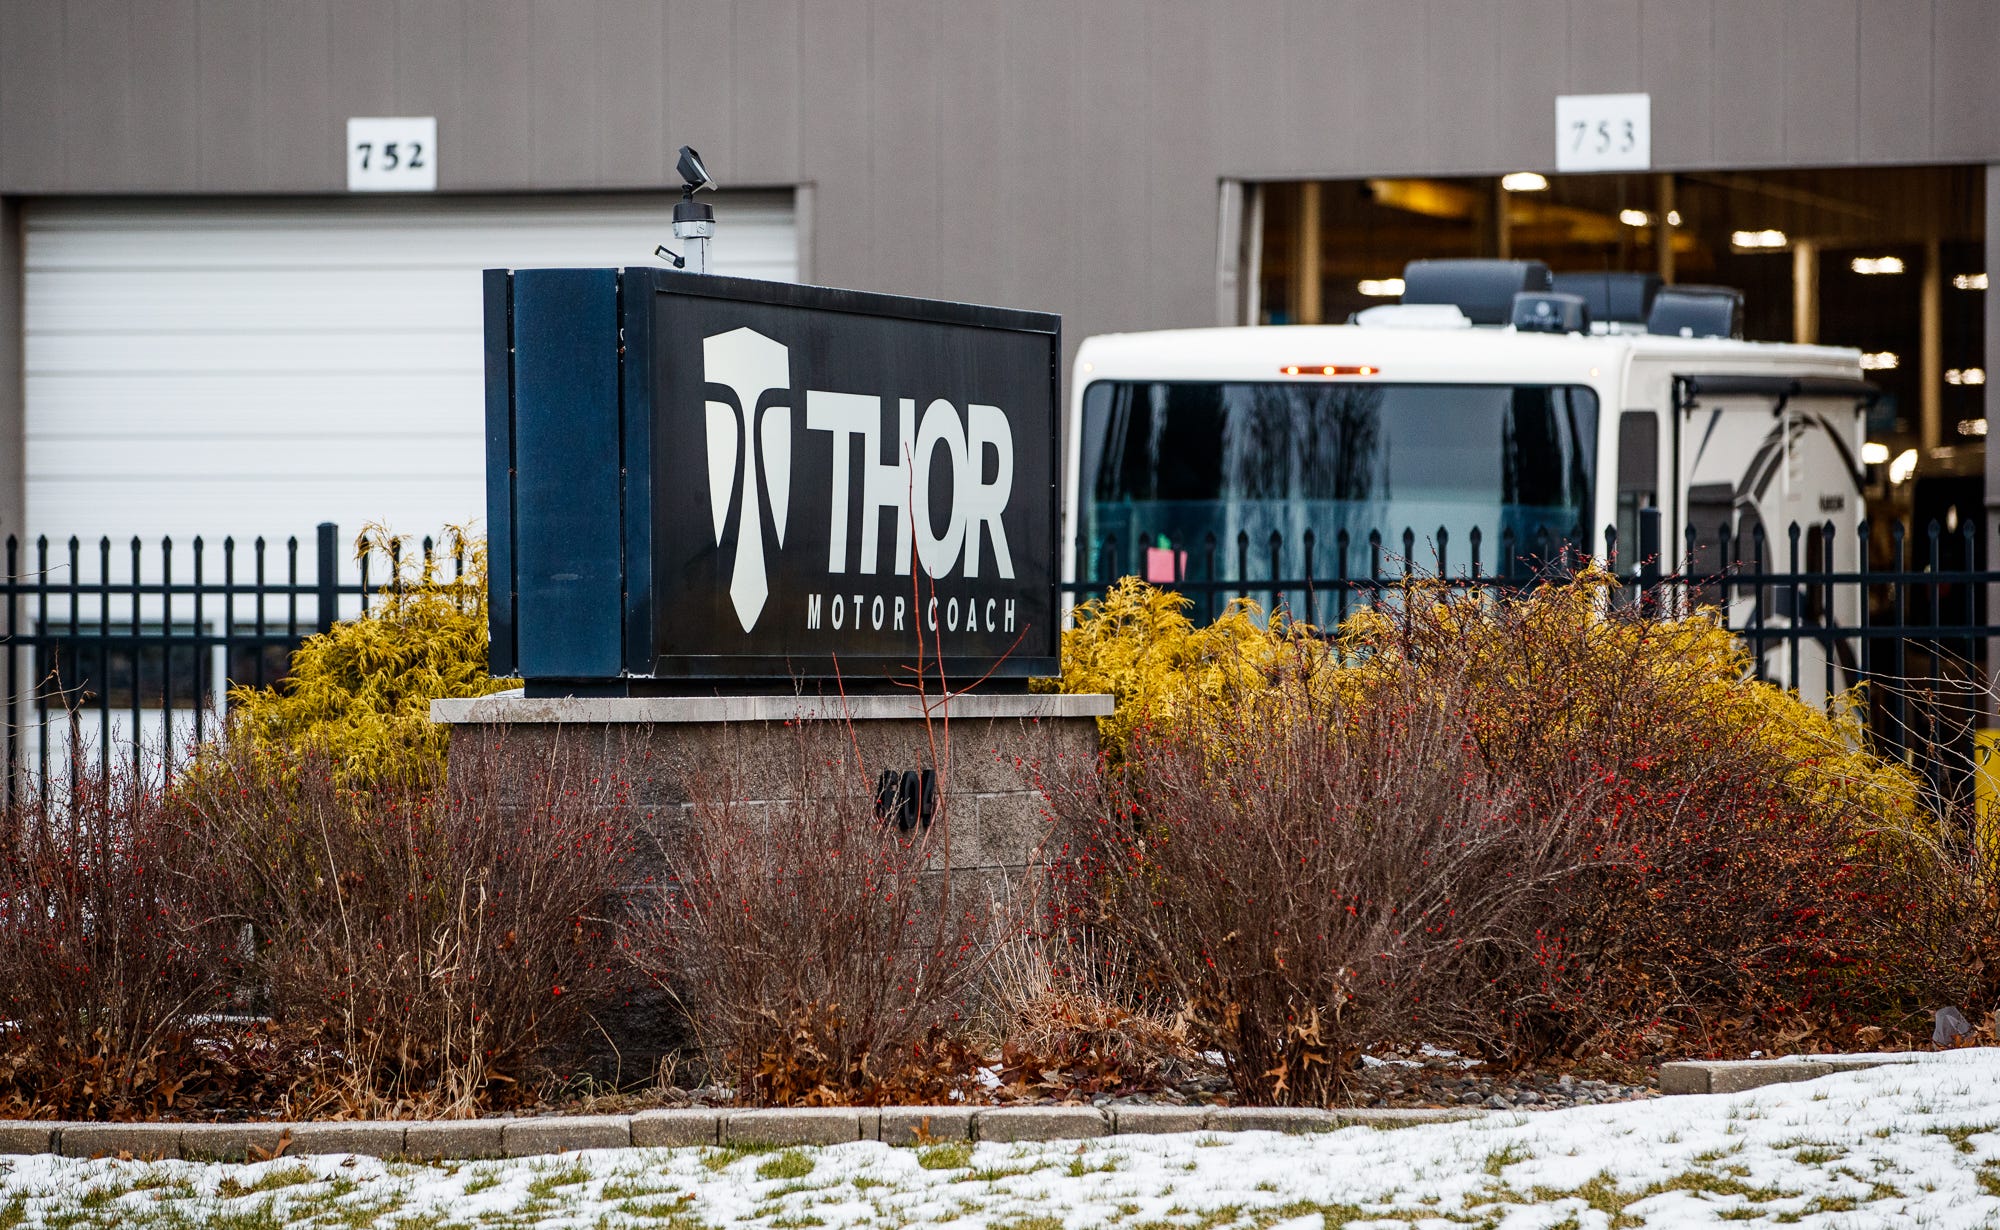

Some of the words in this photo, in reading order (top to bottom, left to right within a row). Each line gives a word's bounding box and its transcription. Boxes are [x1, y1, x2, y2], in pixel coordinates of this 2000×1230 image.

[1571, 120, 1635, 154] 753
[357, 142, 424, 170] 752
[806, 390, 1016, 580] THOR
[807, 594, 905, 631] MOTOR
[927, 597, 1016, 633] COACH
